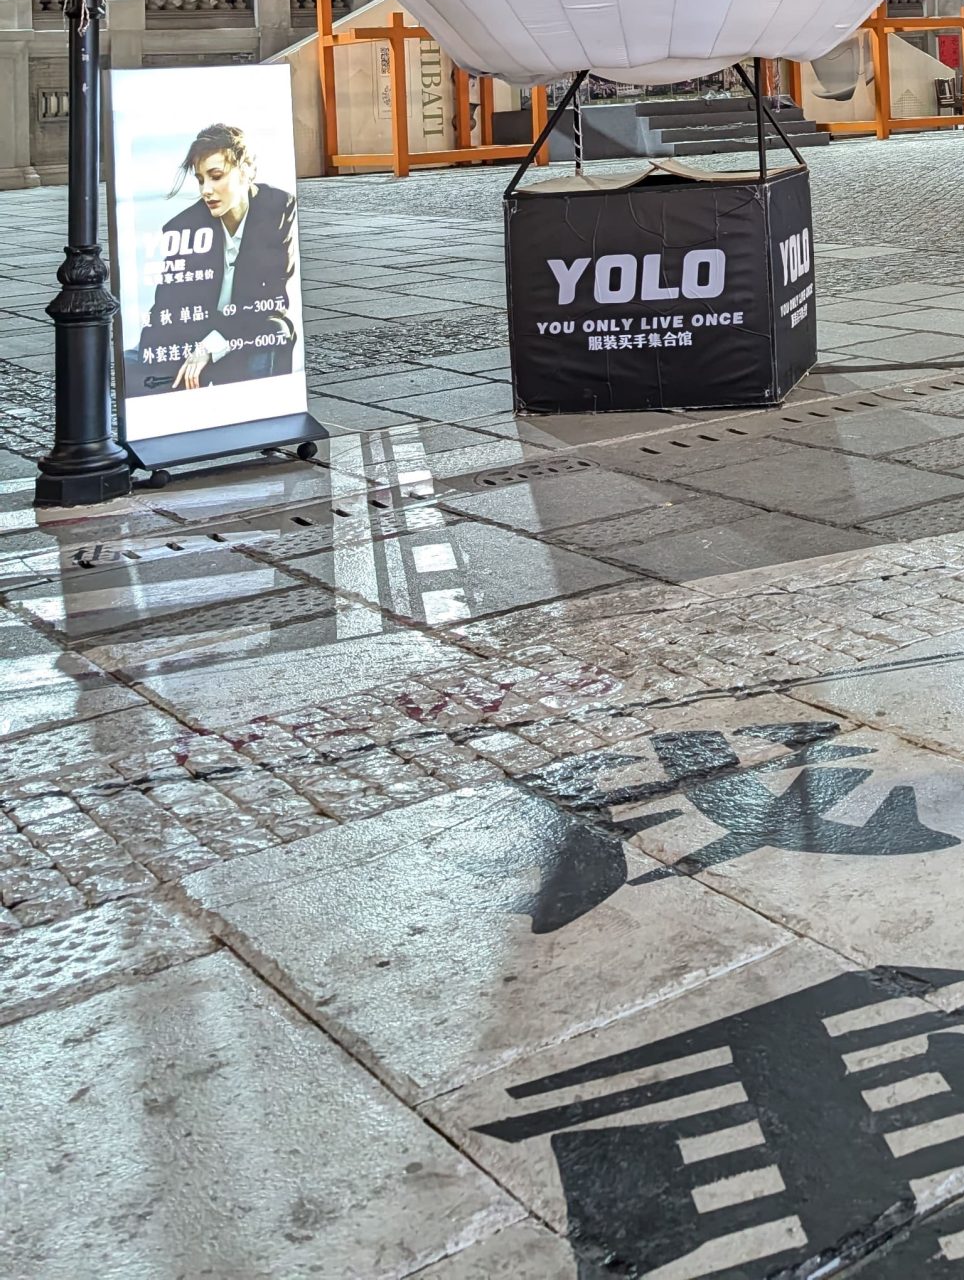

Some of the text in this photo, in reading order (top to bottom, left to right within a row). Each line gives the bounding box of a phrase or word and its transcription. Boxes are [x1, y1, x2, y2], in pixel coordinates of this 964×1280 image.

[779, 227, 810, 287] YOLO
[546, 249, 726, 305] YOLO
[222, 304, 237, 317] 69
[537, 312, 744, 335] YOU ONLY LIVE ONCE
[588, 332, 693, 351] 服装买手集合馆
